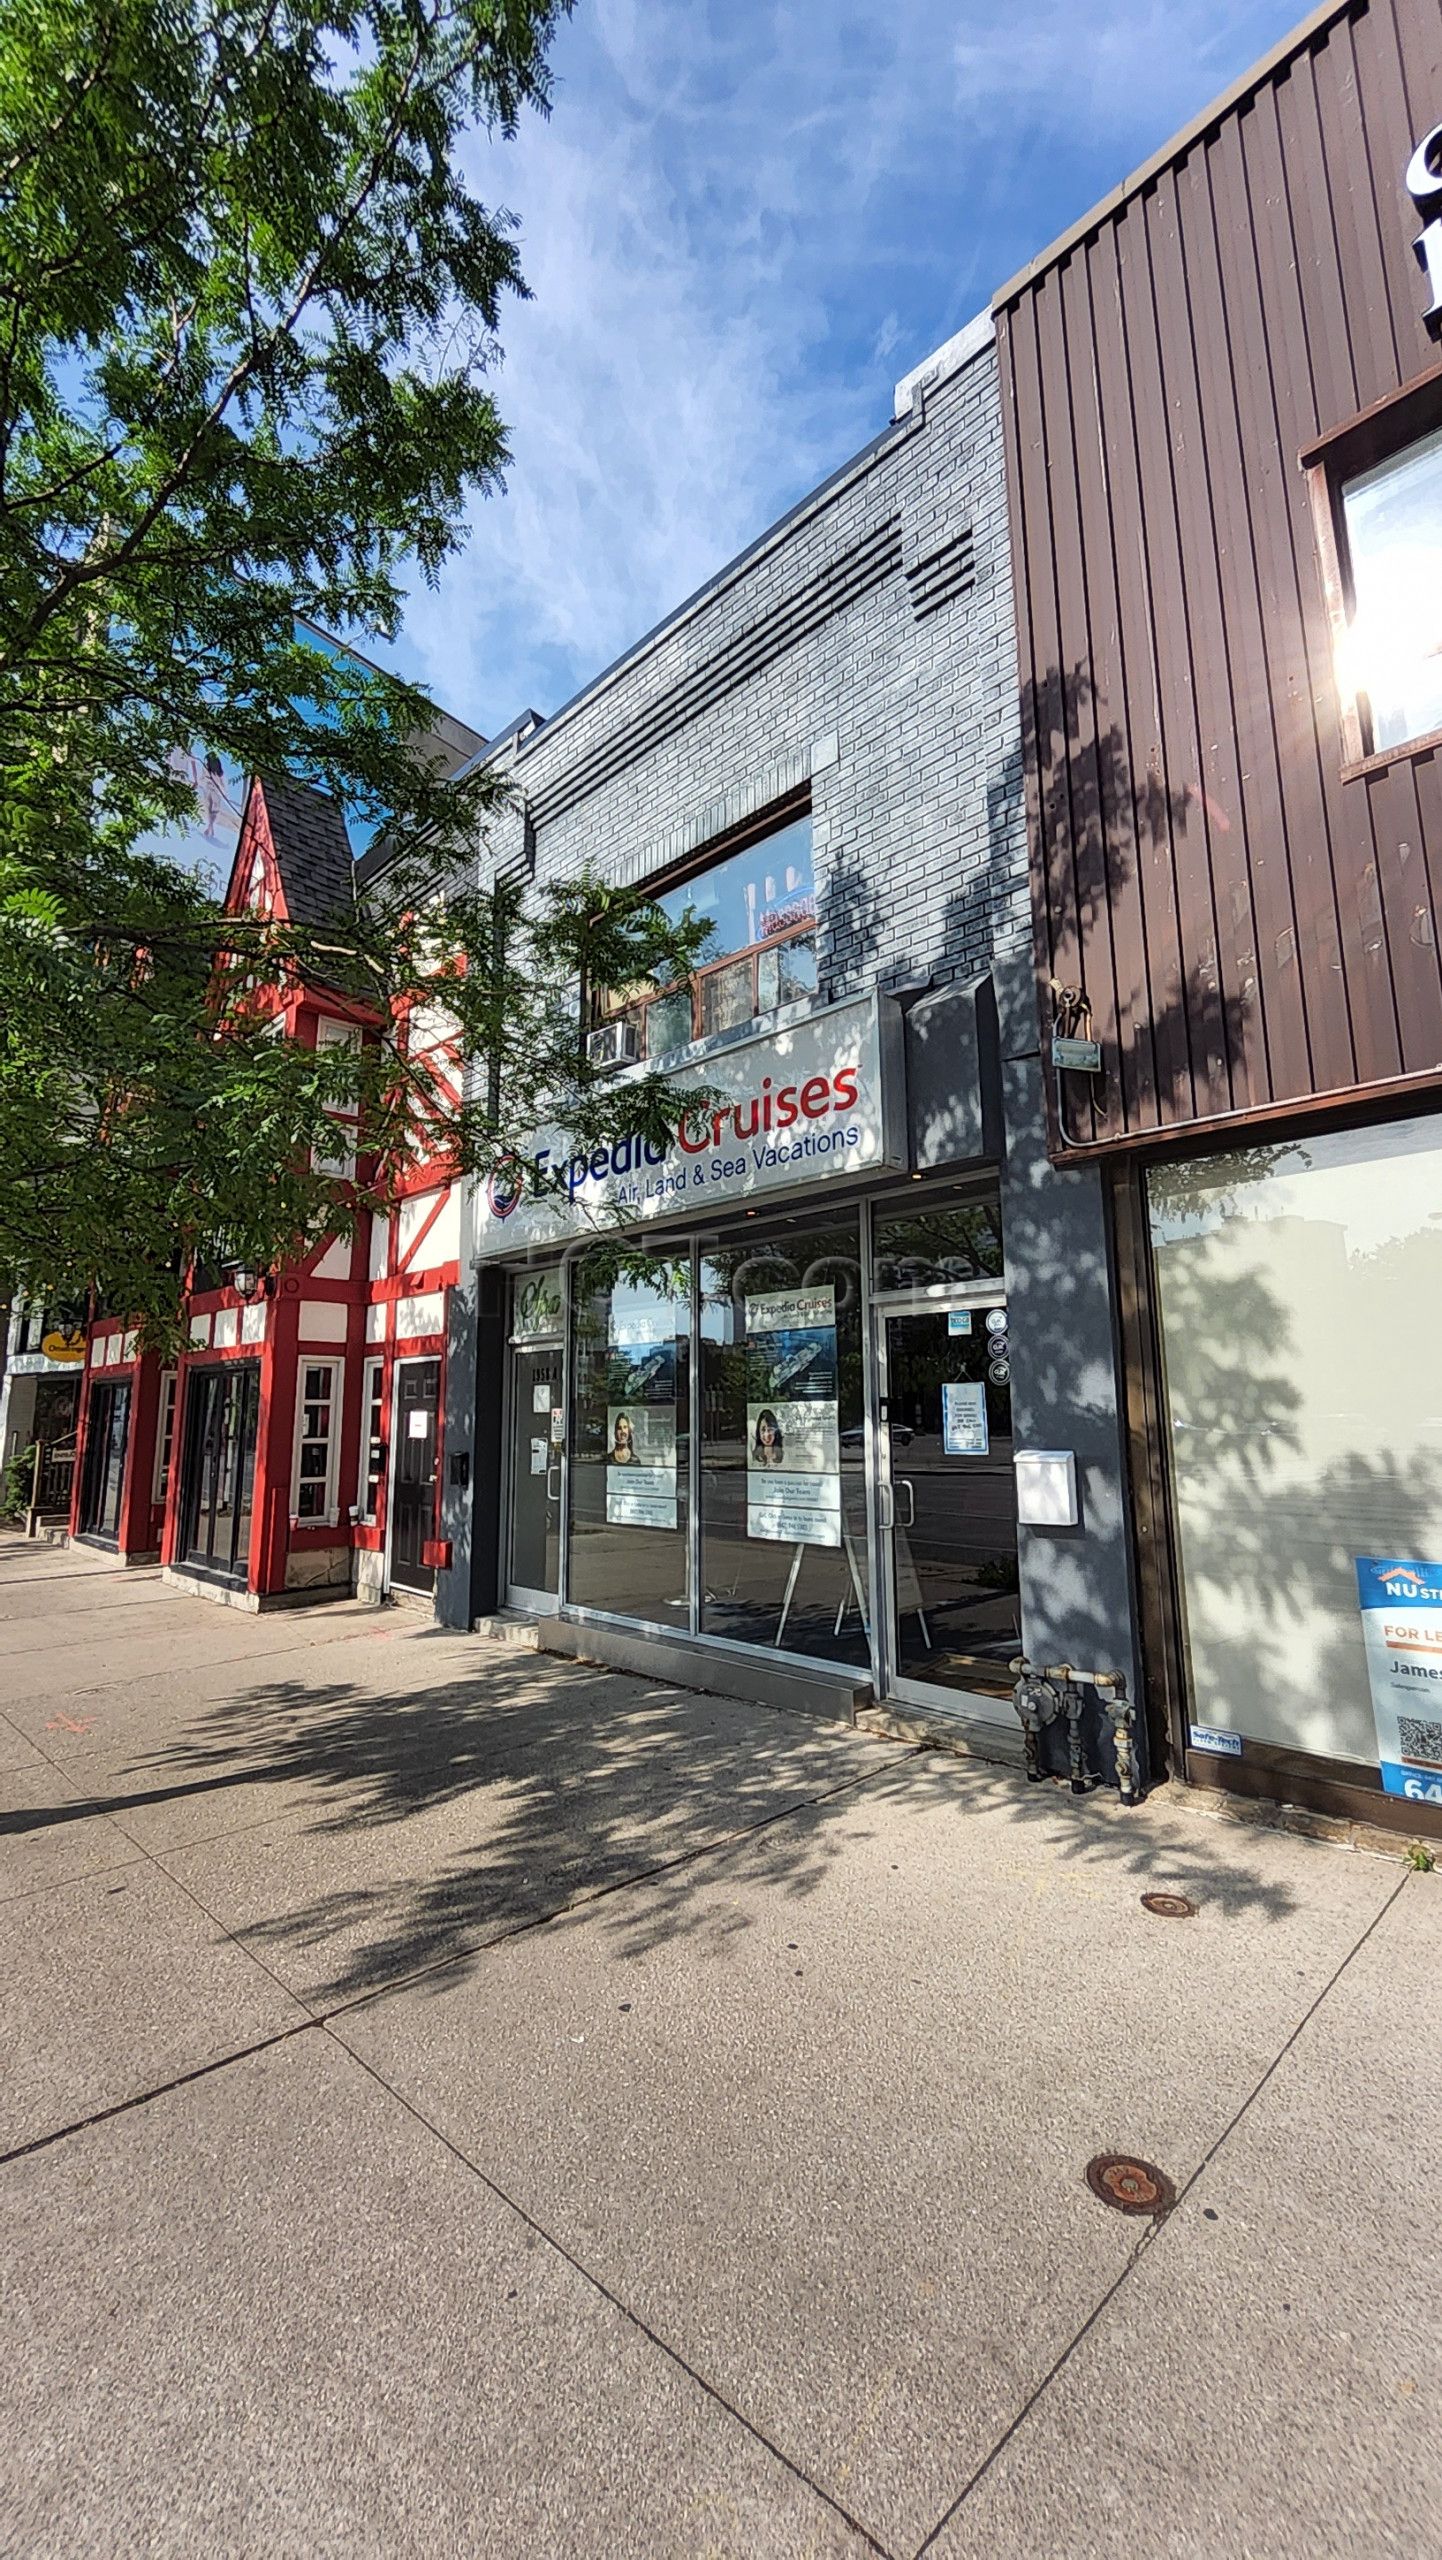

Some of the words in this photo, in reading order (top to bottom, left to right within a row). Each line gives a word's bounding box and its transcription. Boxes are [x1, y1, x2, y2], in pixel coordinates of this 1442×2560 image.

[678, 1067, 858, 1154] Cruises
[618, 1183, 641, 1204] Air,
[645, 1167, 687, 1199] Land
[693, 1165, 706, 1186] &
[711, 1157, 746, 1181] Sea
[753, 1126, 859, 1170] Vacations
[797, 1297, 832, 1311] Cruises
[1386, 1582, 1417, 1598] NU
[1420, 1588, 1442, 1600] ST
[1384, 1625, 1419, 1640] FOR
